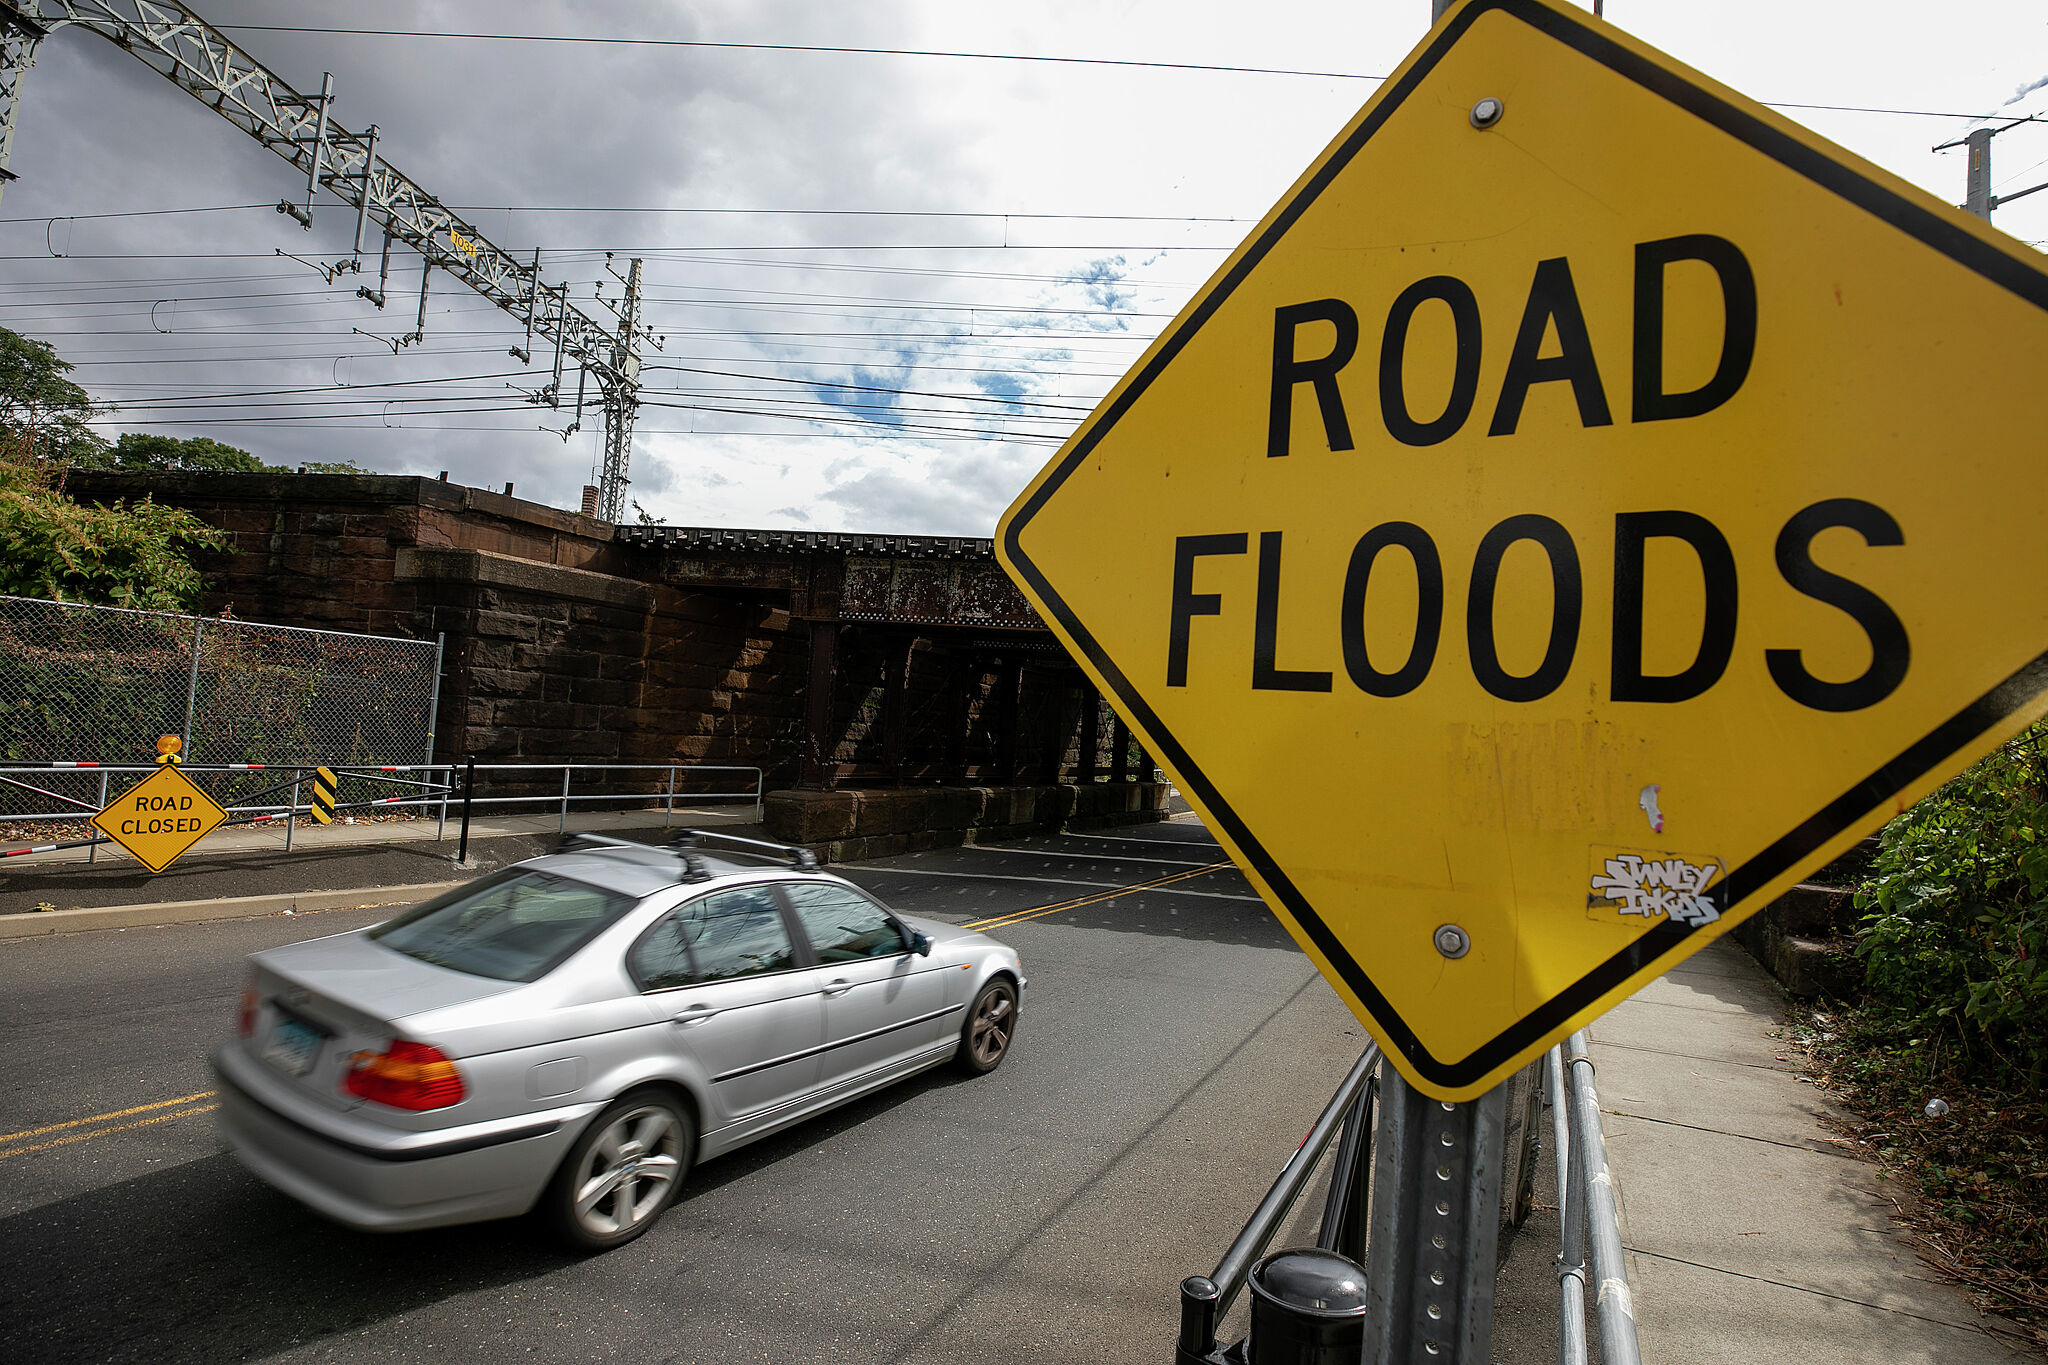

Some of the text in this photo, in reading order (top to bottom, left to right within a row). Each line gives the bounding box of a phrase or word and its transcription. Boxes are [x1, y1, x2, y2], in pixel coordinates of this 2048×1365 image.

[1268, 234, 1757, 458] ROAD
[1167, 499, 1909, 712] FLOODS
[121, 818, 201, 835] CLOSED
[136, 797, 192, 811] ROAD
